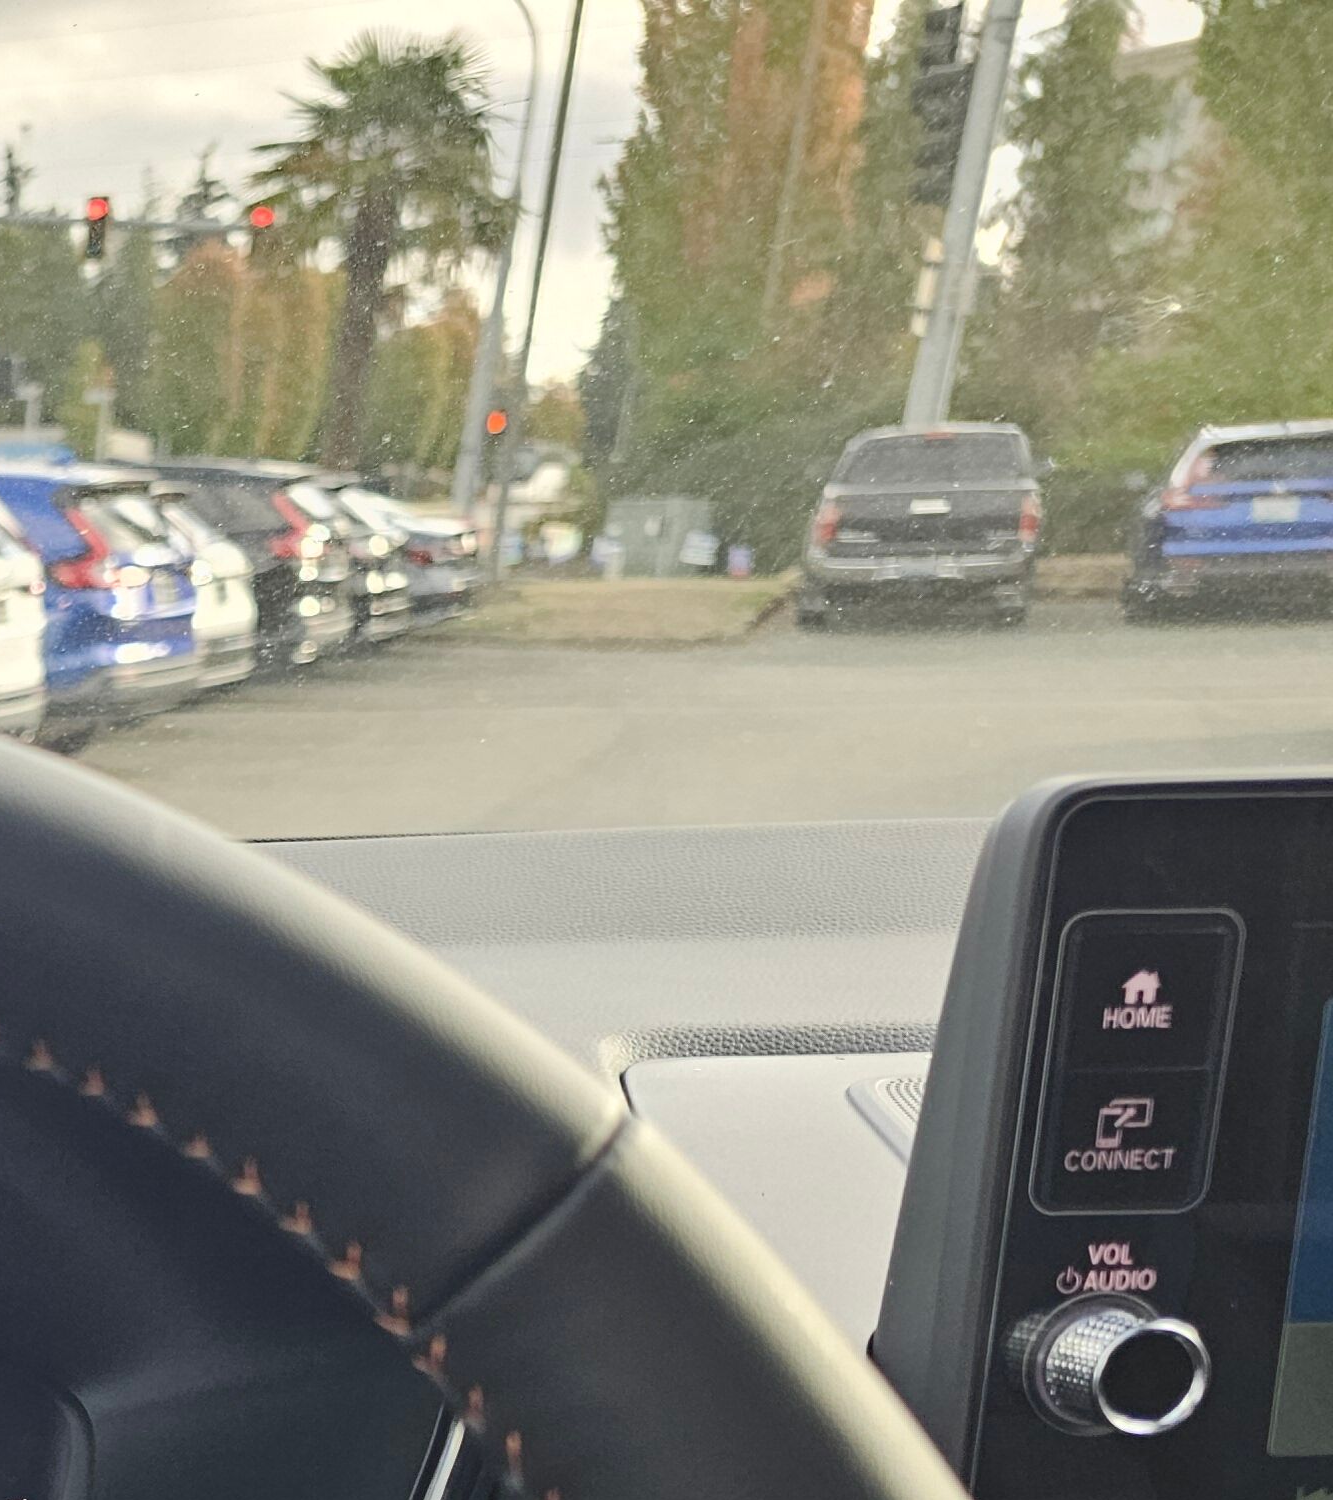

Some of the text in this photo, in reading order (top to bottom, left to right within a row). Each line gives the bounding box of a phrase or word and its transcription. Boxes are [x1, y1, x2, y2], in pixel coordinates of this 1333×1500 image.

[1102, 1006, 1172, 1030] HOME
[1063, 1148, 1177, 1173] CONNECT
[1088, 1242, 1133, 1267] VOL
[1083, 1268, 1157, 1293] AUDIO
